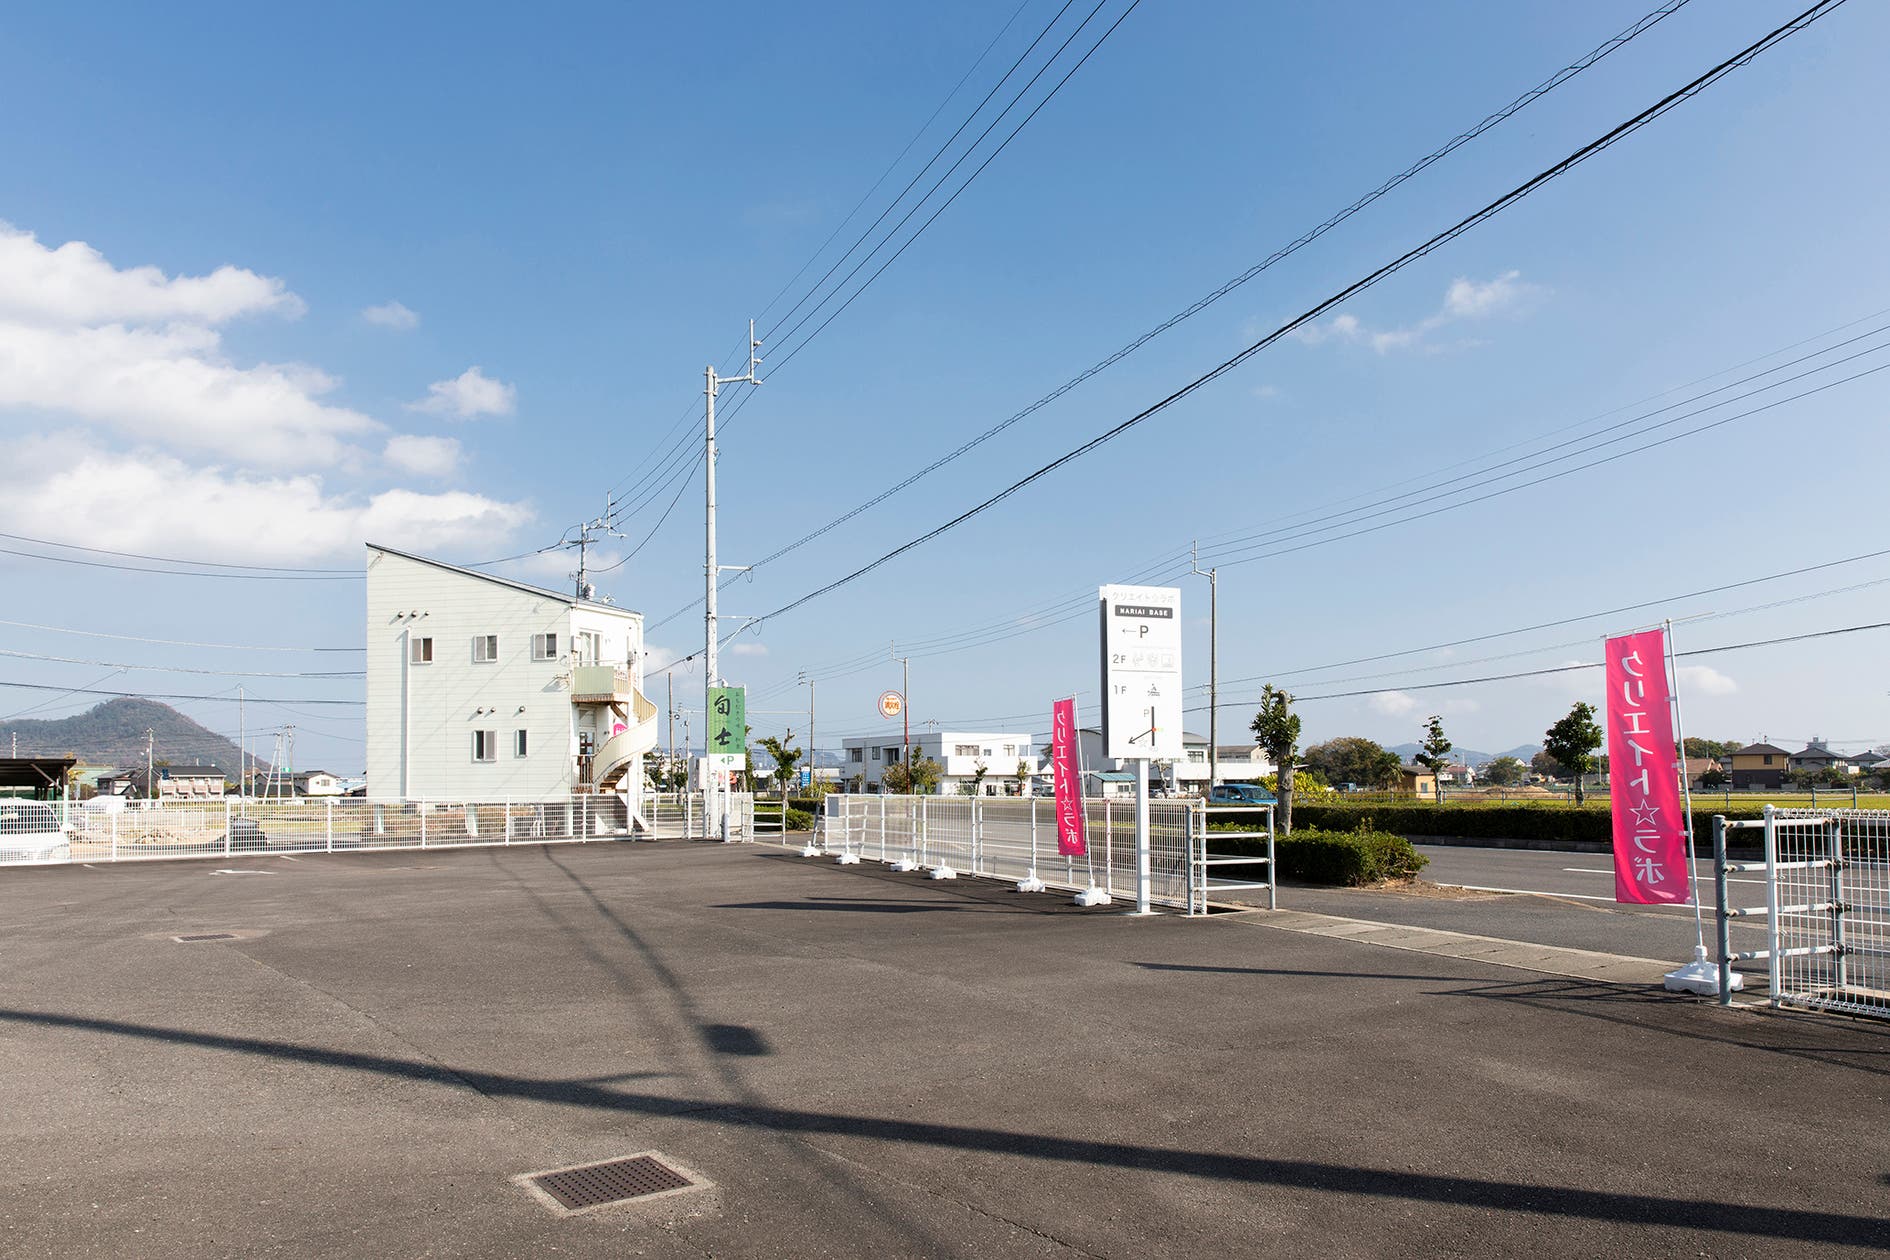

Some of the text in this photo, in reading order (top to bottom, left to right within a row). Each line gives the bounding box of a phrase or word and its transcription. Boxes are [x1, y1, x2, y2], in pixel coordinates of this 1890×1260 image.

[1119, 607, 1168, 616] NARIAI BASE
[1139, 625, 1149, 638] P
[1112, 653, 1127, 664] 2F
[727, 755, 735, 765] P
